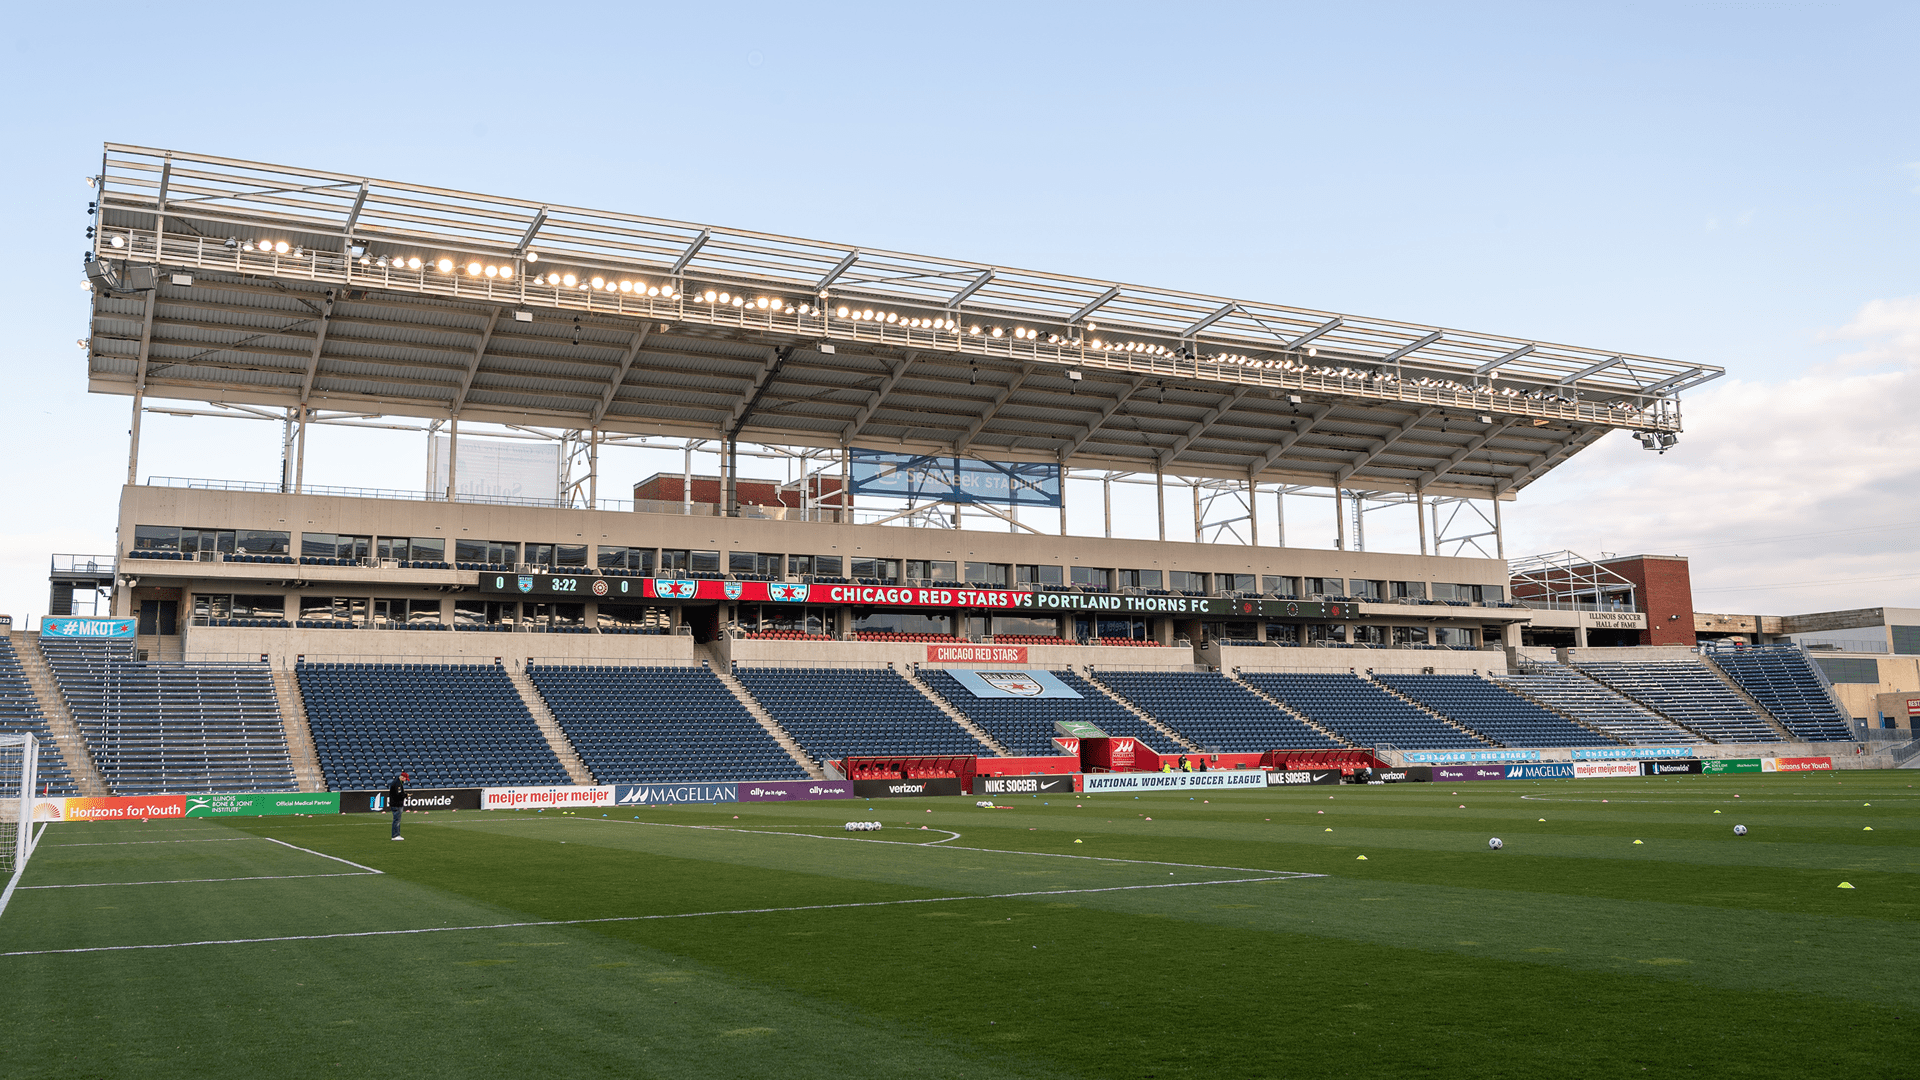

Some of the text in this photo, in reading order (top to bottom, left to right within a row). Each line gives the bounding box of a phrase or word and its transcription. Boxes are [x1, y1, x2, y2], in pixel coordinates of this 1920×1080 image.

[906, 468, 1043, 491] SeatGeek STADIUM
[496, 576, 504, 589] 0
[552, 578, 577, 592] 3:22
[621, 580, 629, 593] 0
[830, 587, 1209, 613] CHICAGO RED STARS VS PORTLAND THORNS FC
[63, 621, 116, 636] #MKOT
[938, 647, 1018, 661] CHICAGO RED STARS
[1380, 771, 1405, 780] verizon
[1525, 766, 1574, 777] MAGELLAN
[1577, 763, 1637, 775] meijer meijer meijer
[1089, 774, 1262, 789] NATIONAL WOMEN'S SOCCER LEAGUE
[1268, 772, 1311, 784] NIKE SOCCER
[750, 787, 765, 798] ally
[809, 785, 823, 796] ally
[889, 783, 923, 793] verizon
[985, 779, 1038, 793] NIKE SOCCER
[488, 788, 609, 806] meijer meijer meijer
[650, 786, 736, 802] MAGELLAN
[69, 804, 181, 818] Horizons for Youth
